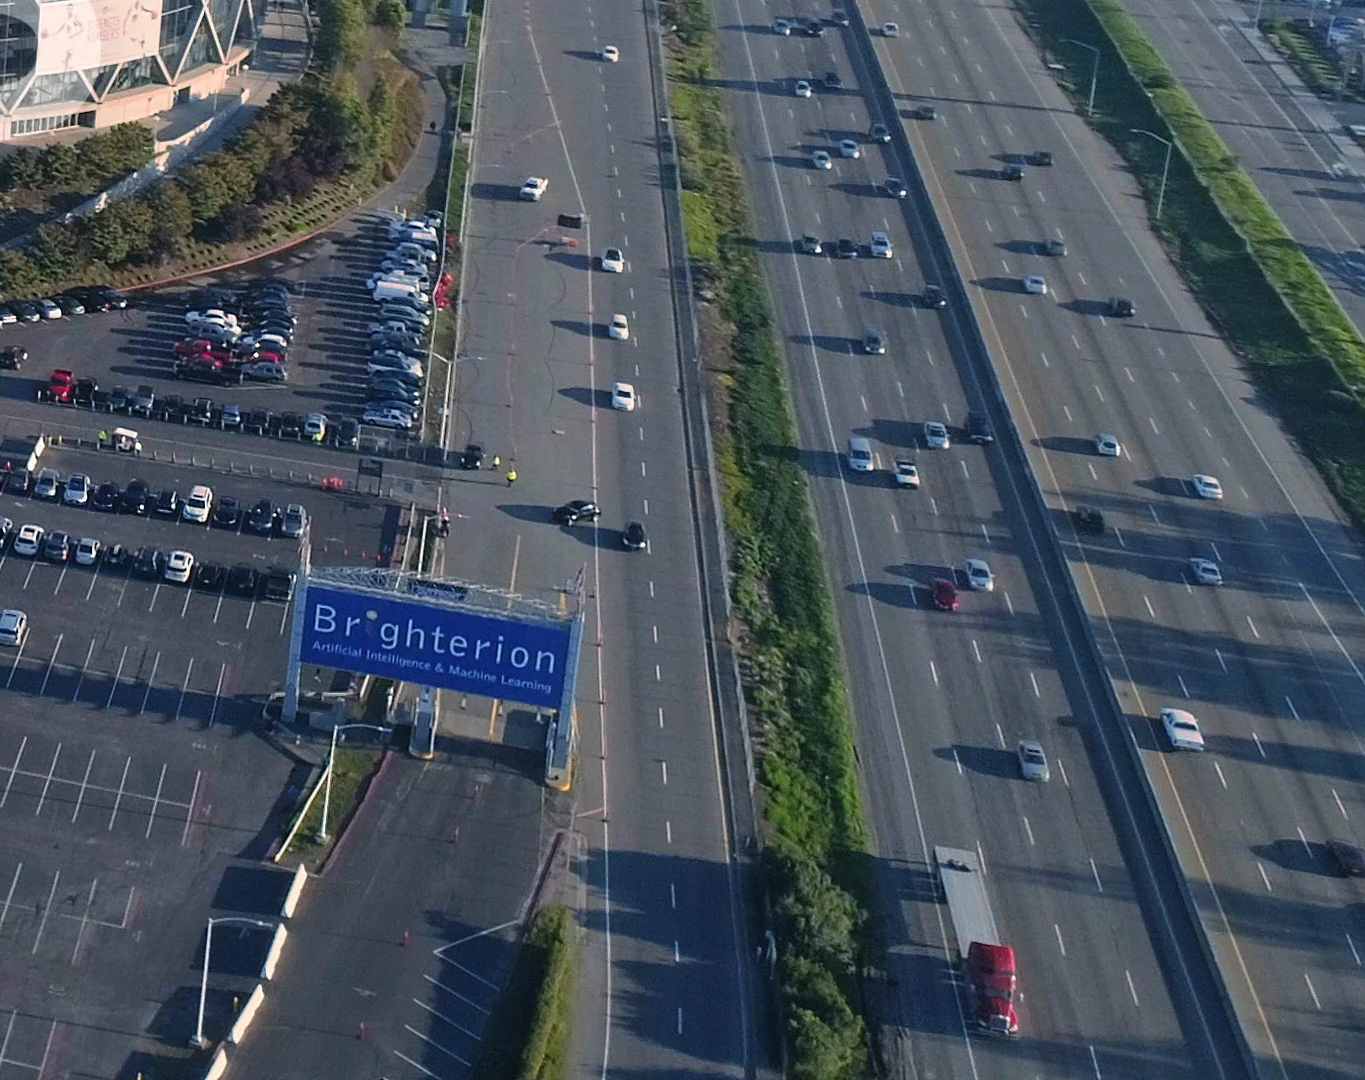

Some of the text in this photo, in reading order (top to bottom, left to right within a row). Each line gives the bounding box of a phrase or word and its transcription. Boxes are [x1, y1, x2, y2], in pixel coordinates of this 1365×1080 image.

[312, 640, 552, 695] Artificial Intelligence & Machine Learning
